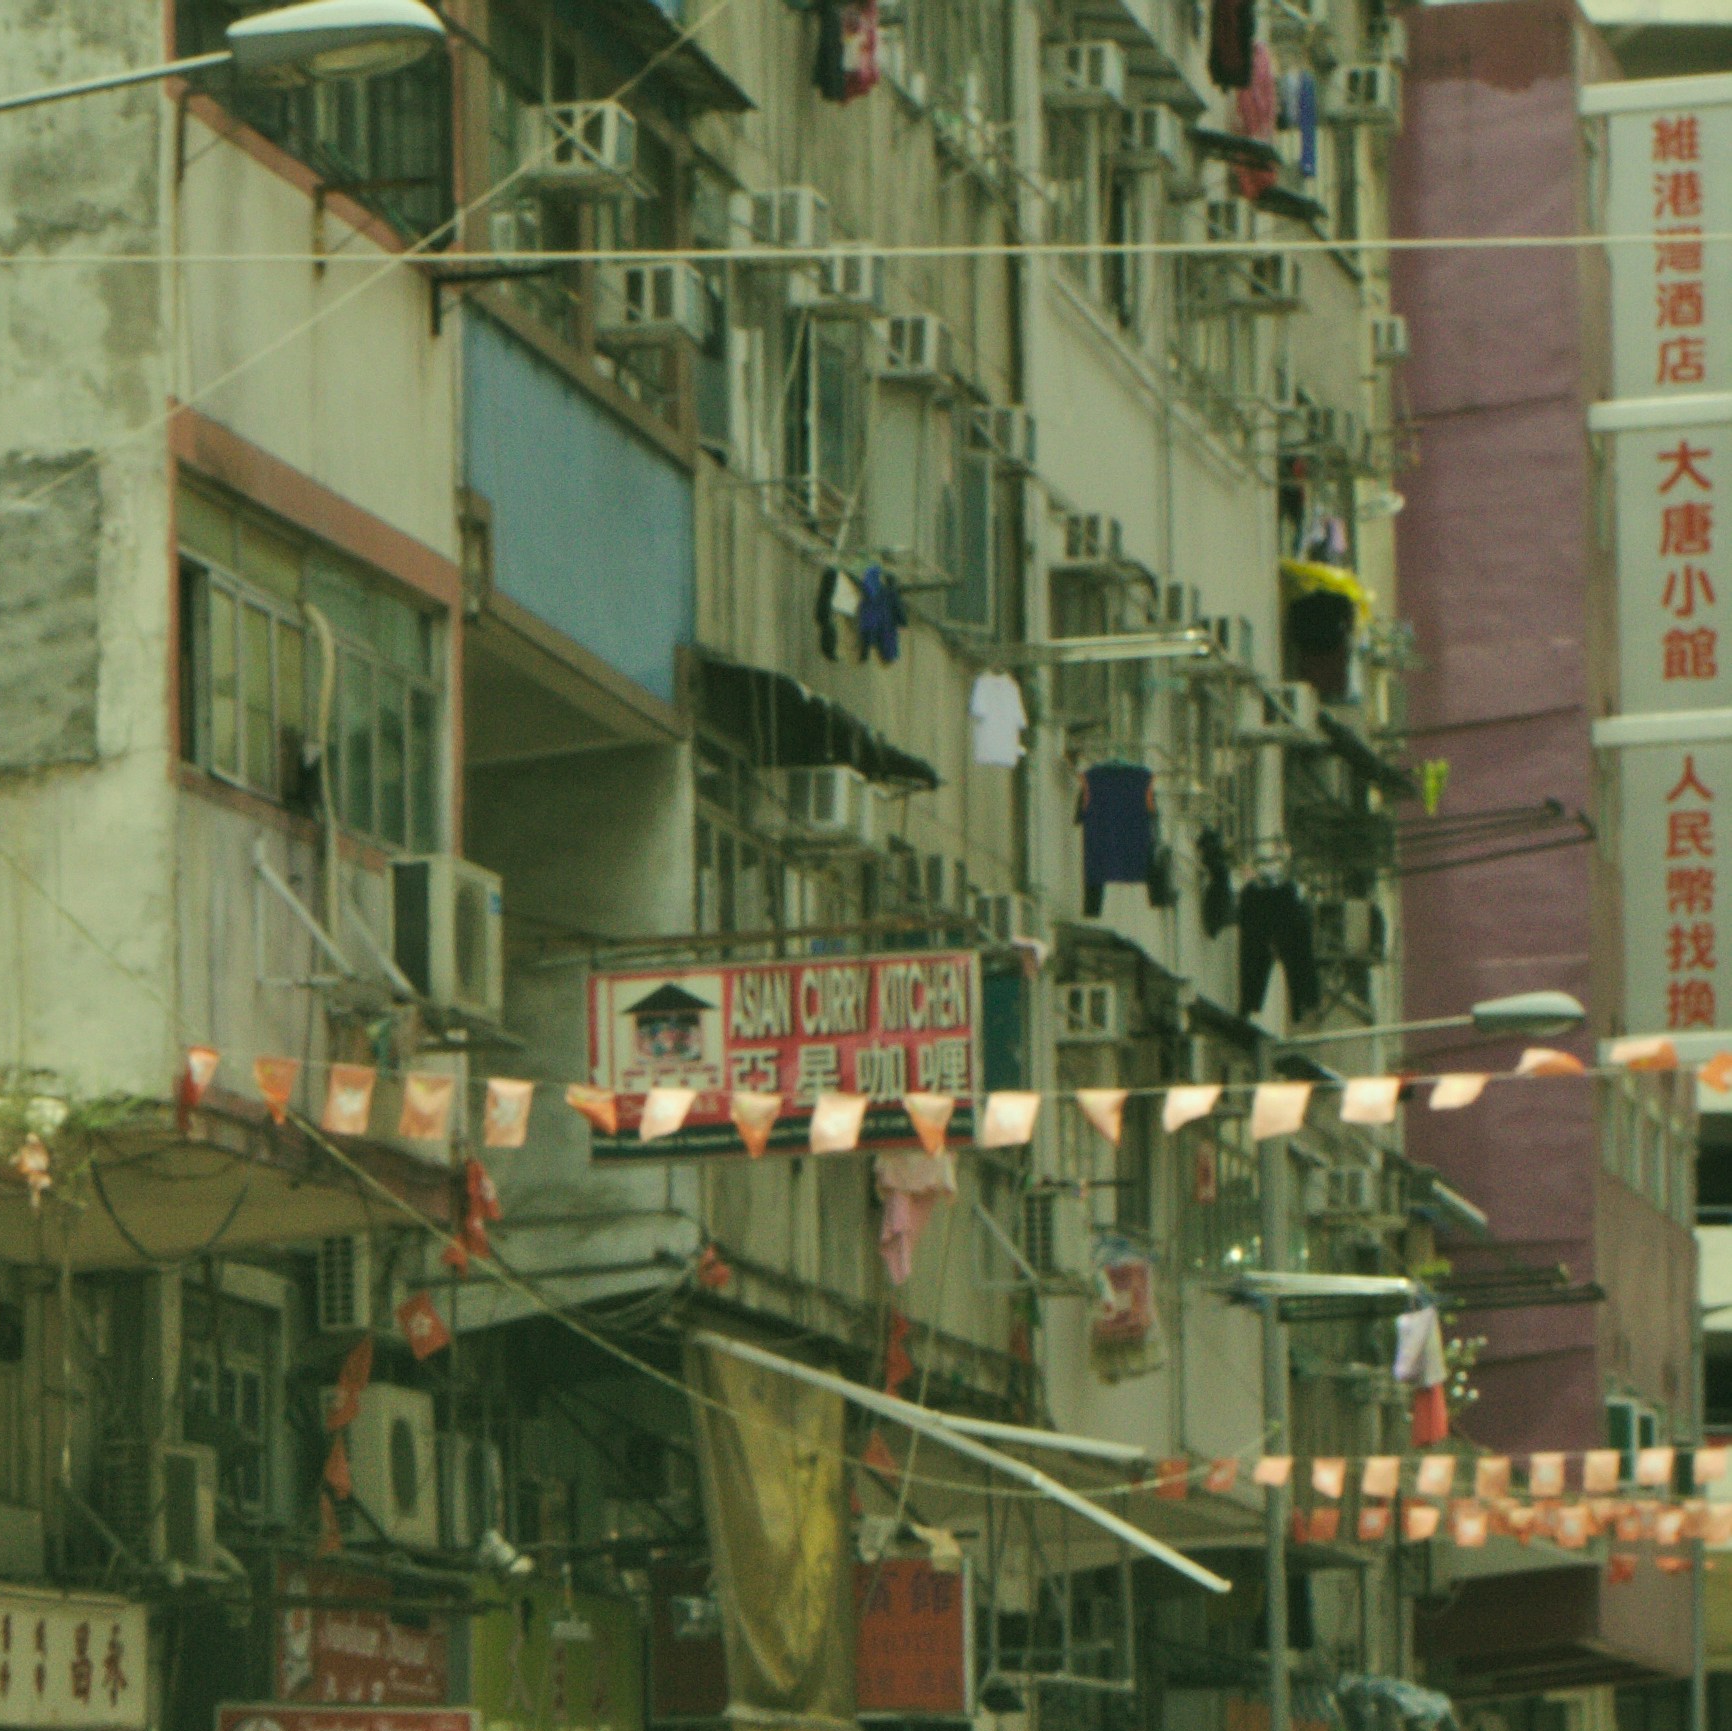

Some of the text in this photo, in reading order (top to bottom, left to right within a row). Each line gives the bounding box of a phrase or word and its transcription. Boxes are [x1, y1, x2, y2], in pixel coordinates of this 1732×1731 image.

[1656, 439, 1717, 681] 大唐小館
[731, 958, 969, 1038] ASIAN CURRY KITCHEN
[1666, 755, 1716, 1029] 人民幣找換
